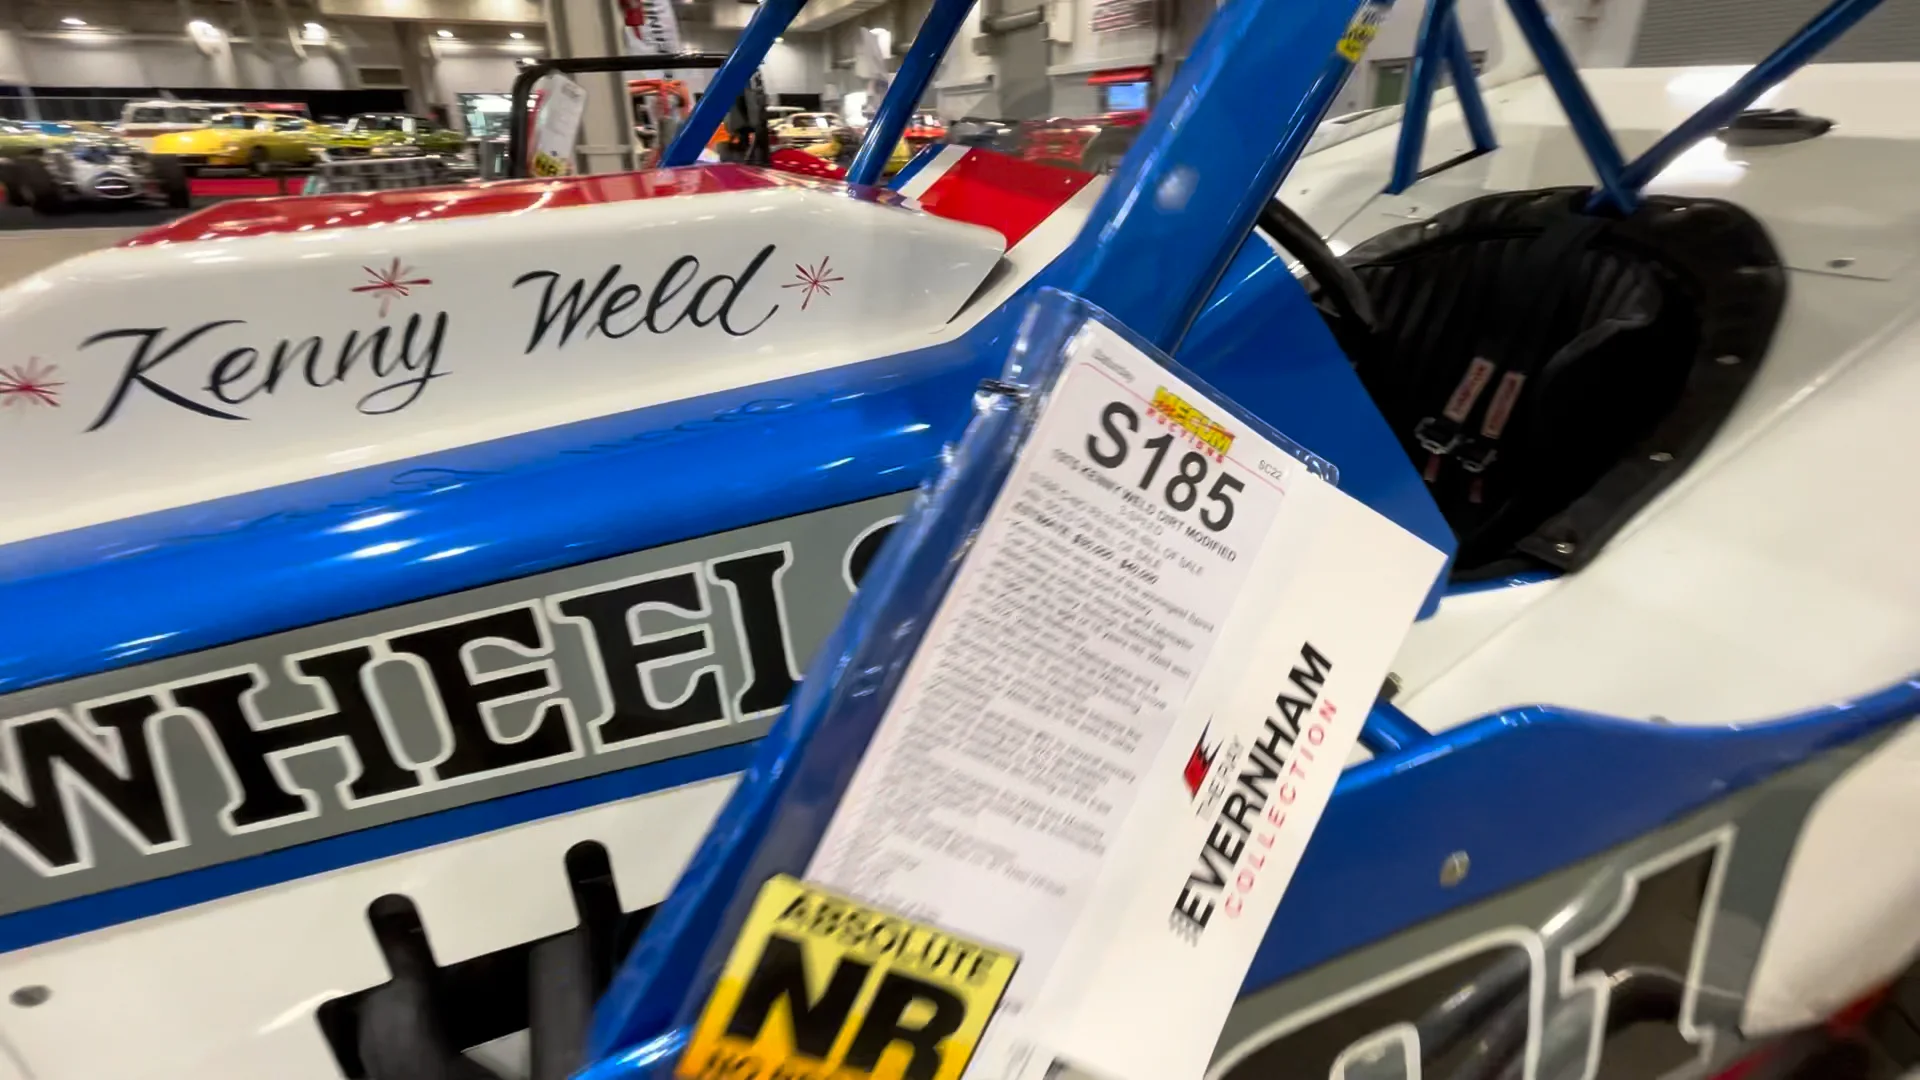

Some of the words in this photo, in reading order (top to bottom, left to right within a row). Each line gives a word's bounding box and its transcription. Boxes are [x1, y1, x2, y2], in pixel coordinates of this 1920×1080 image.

[78, 311, 453, 433] Kenny
[512, 243, 780, 355] Weld
[1086, 400, 1245, 532] S185
[1119, 487, 1157, 516] WELD
[1155, 508, 1185, 532] DIRT
[1183, 525, 1237, 563] MODIFIED
[1256, 458, 1283, 481] SC22
[1173, 641, 1333, 930] EVERNHAM
[1224, 699, 1338, 920] COLLECTION
[723, 932, 966, 1080] NR
[775, 893, 998, 984] ABSOLUTE
